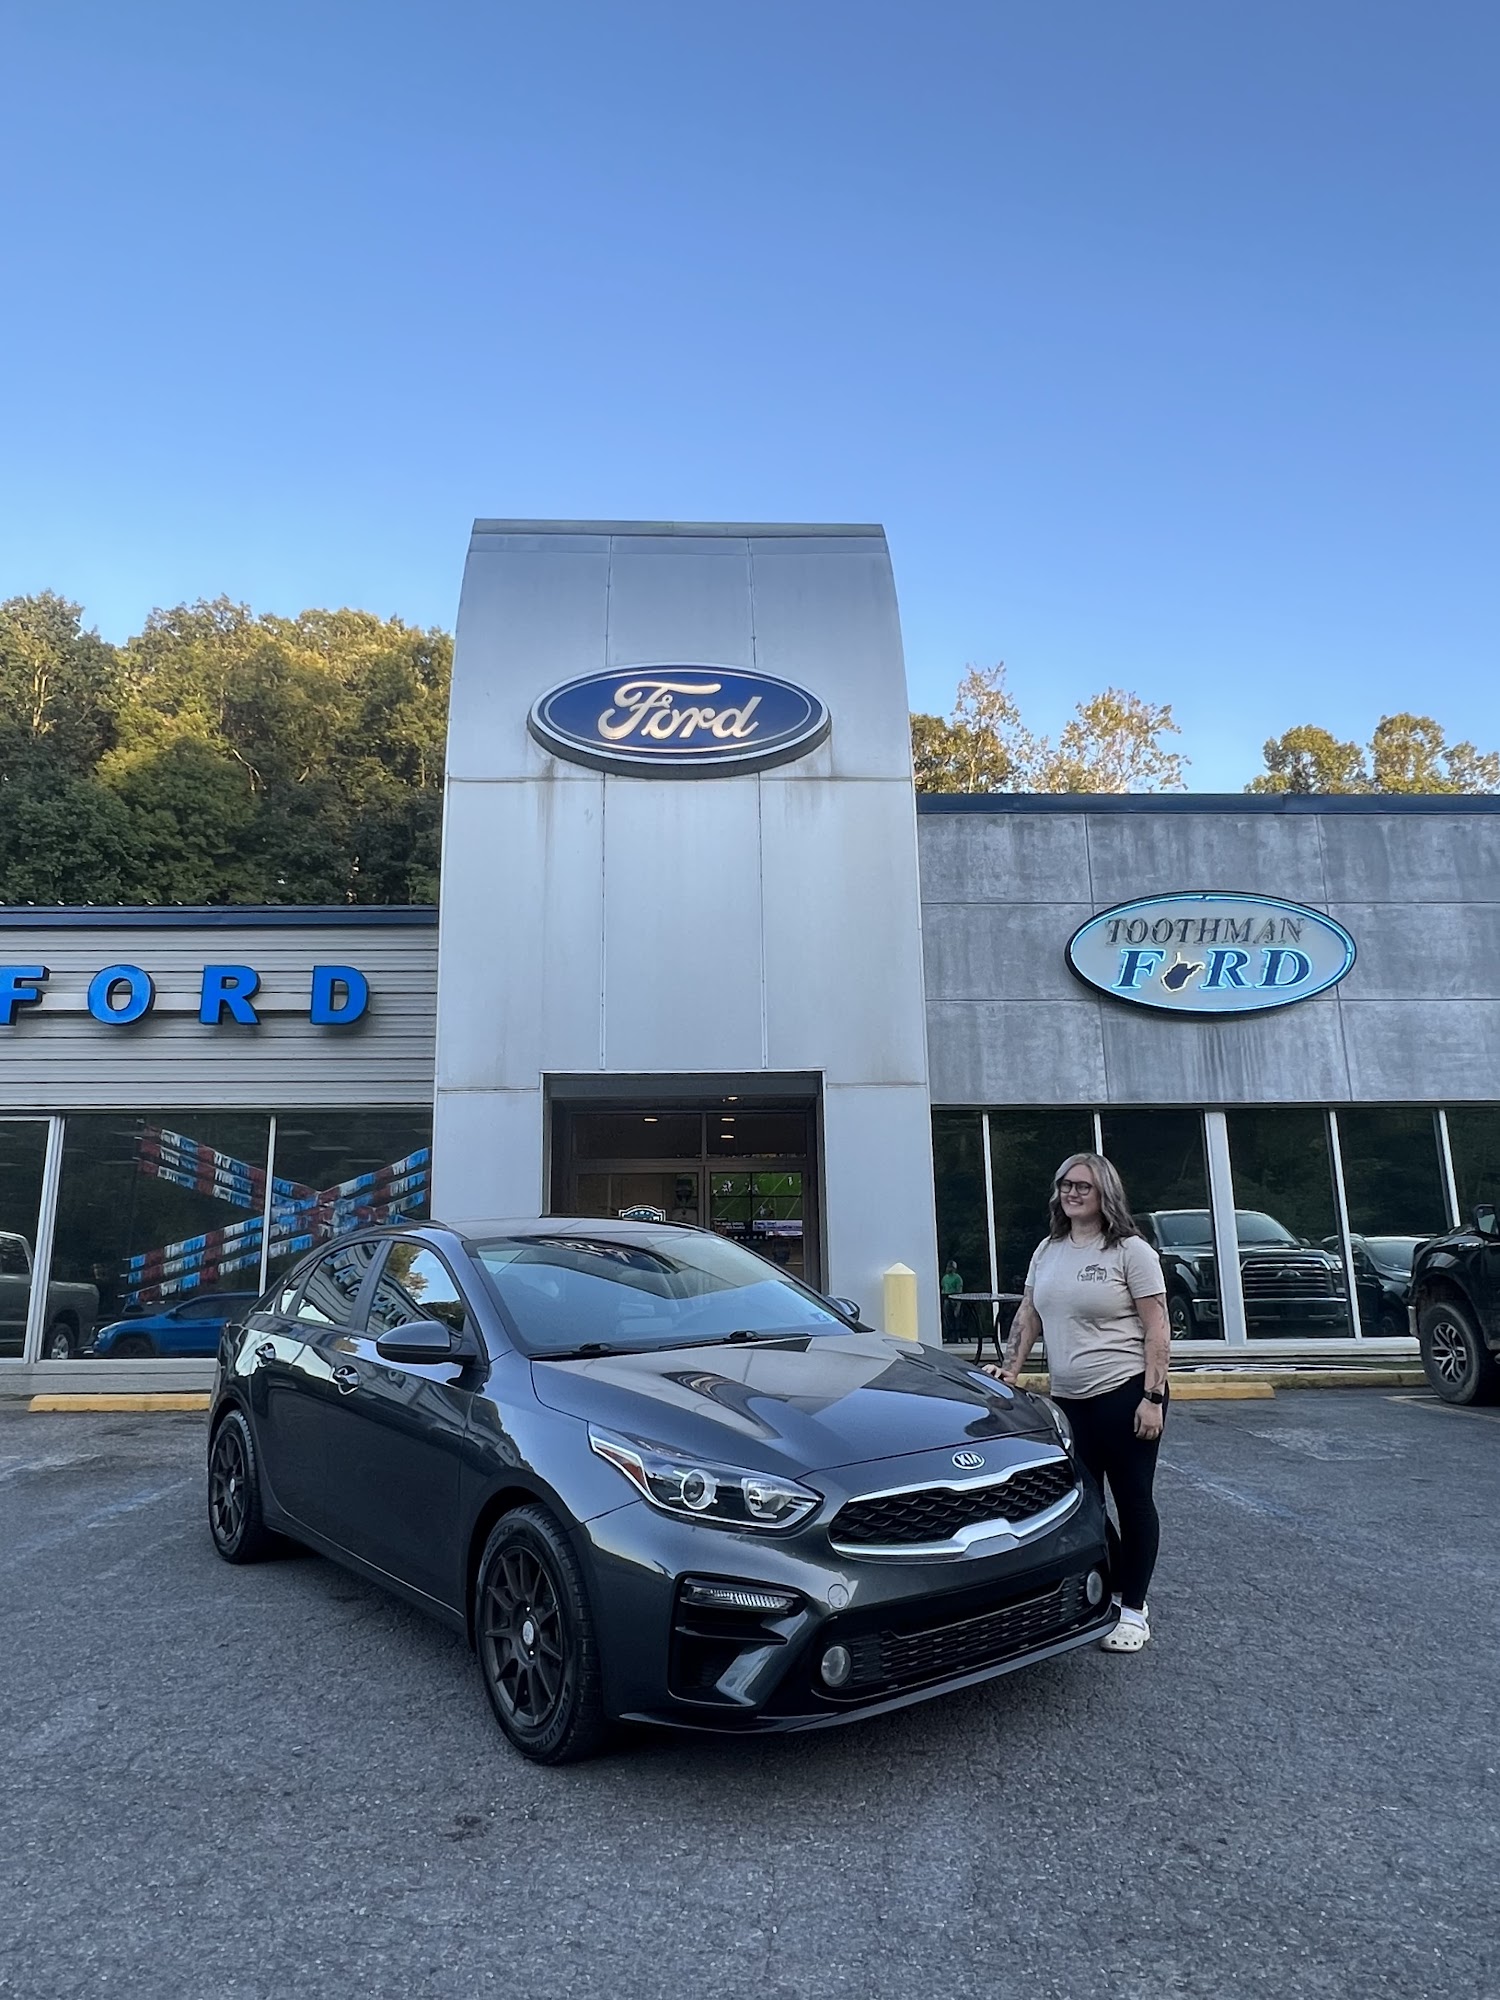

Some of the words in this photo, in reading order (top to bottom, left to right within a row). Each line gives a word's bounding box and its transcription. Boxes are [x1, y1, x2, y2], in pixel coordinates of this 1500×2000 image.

[598, 681, 762, 739] Ford
[1105, 917, 1305, 945] TOOTHMAN
[0, 964, 371, 1026] FORD
[955, 1452, 983, 1467] KIA
